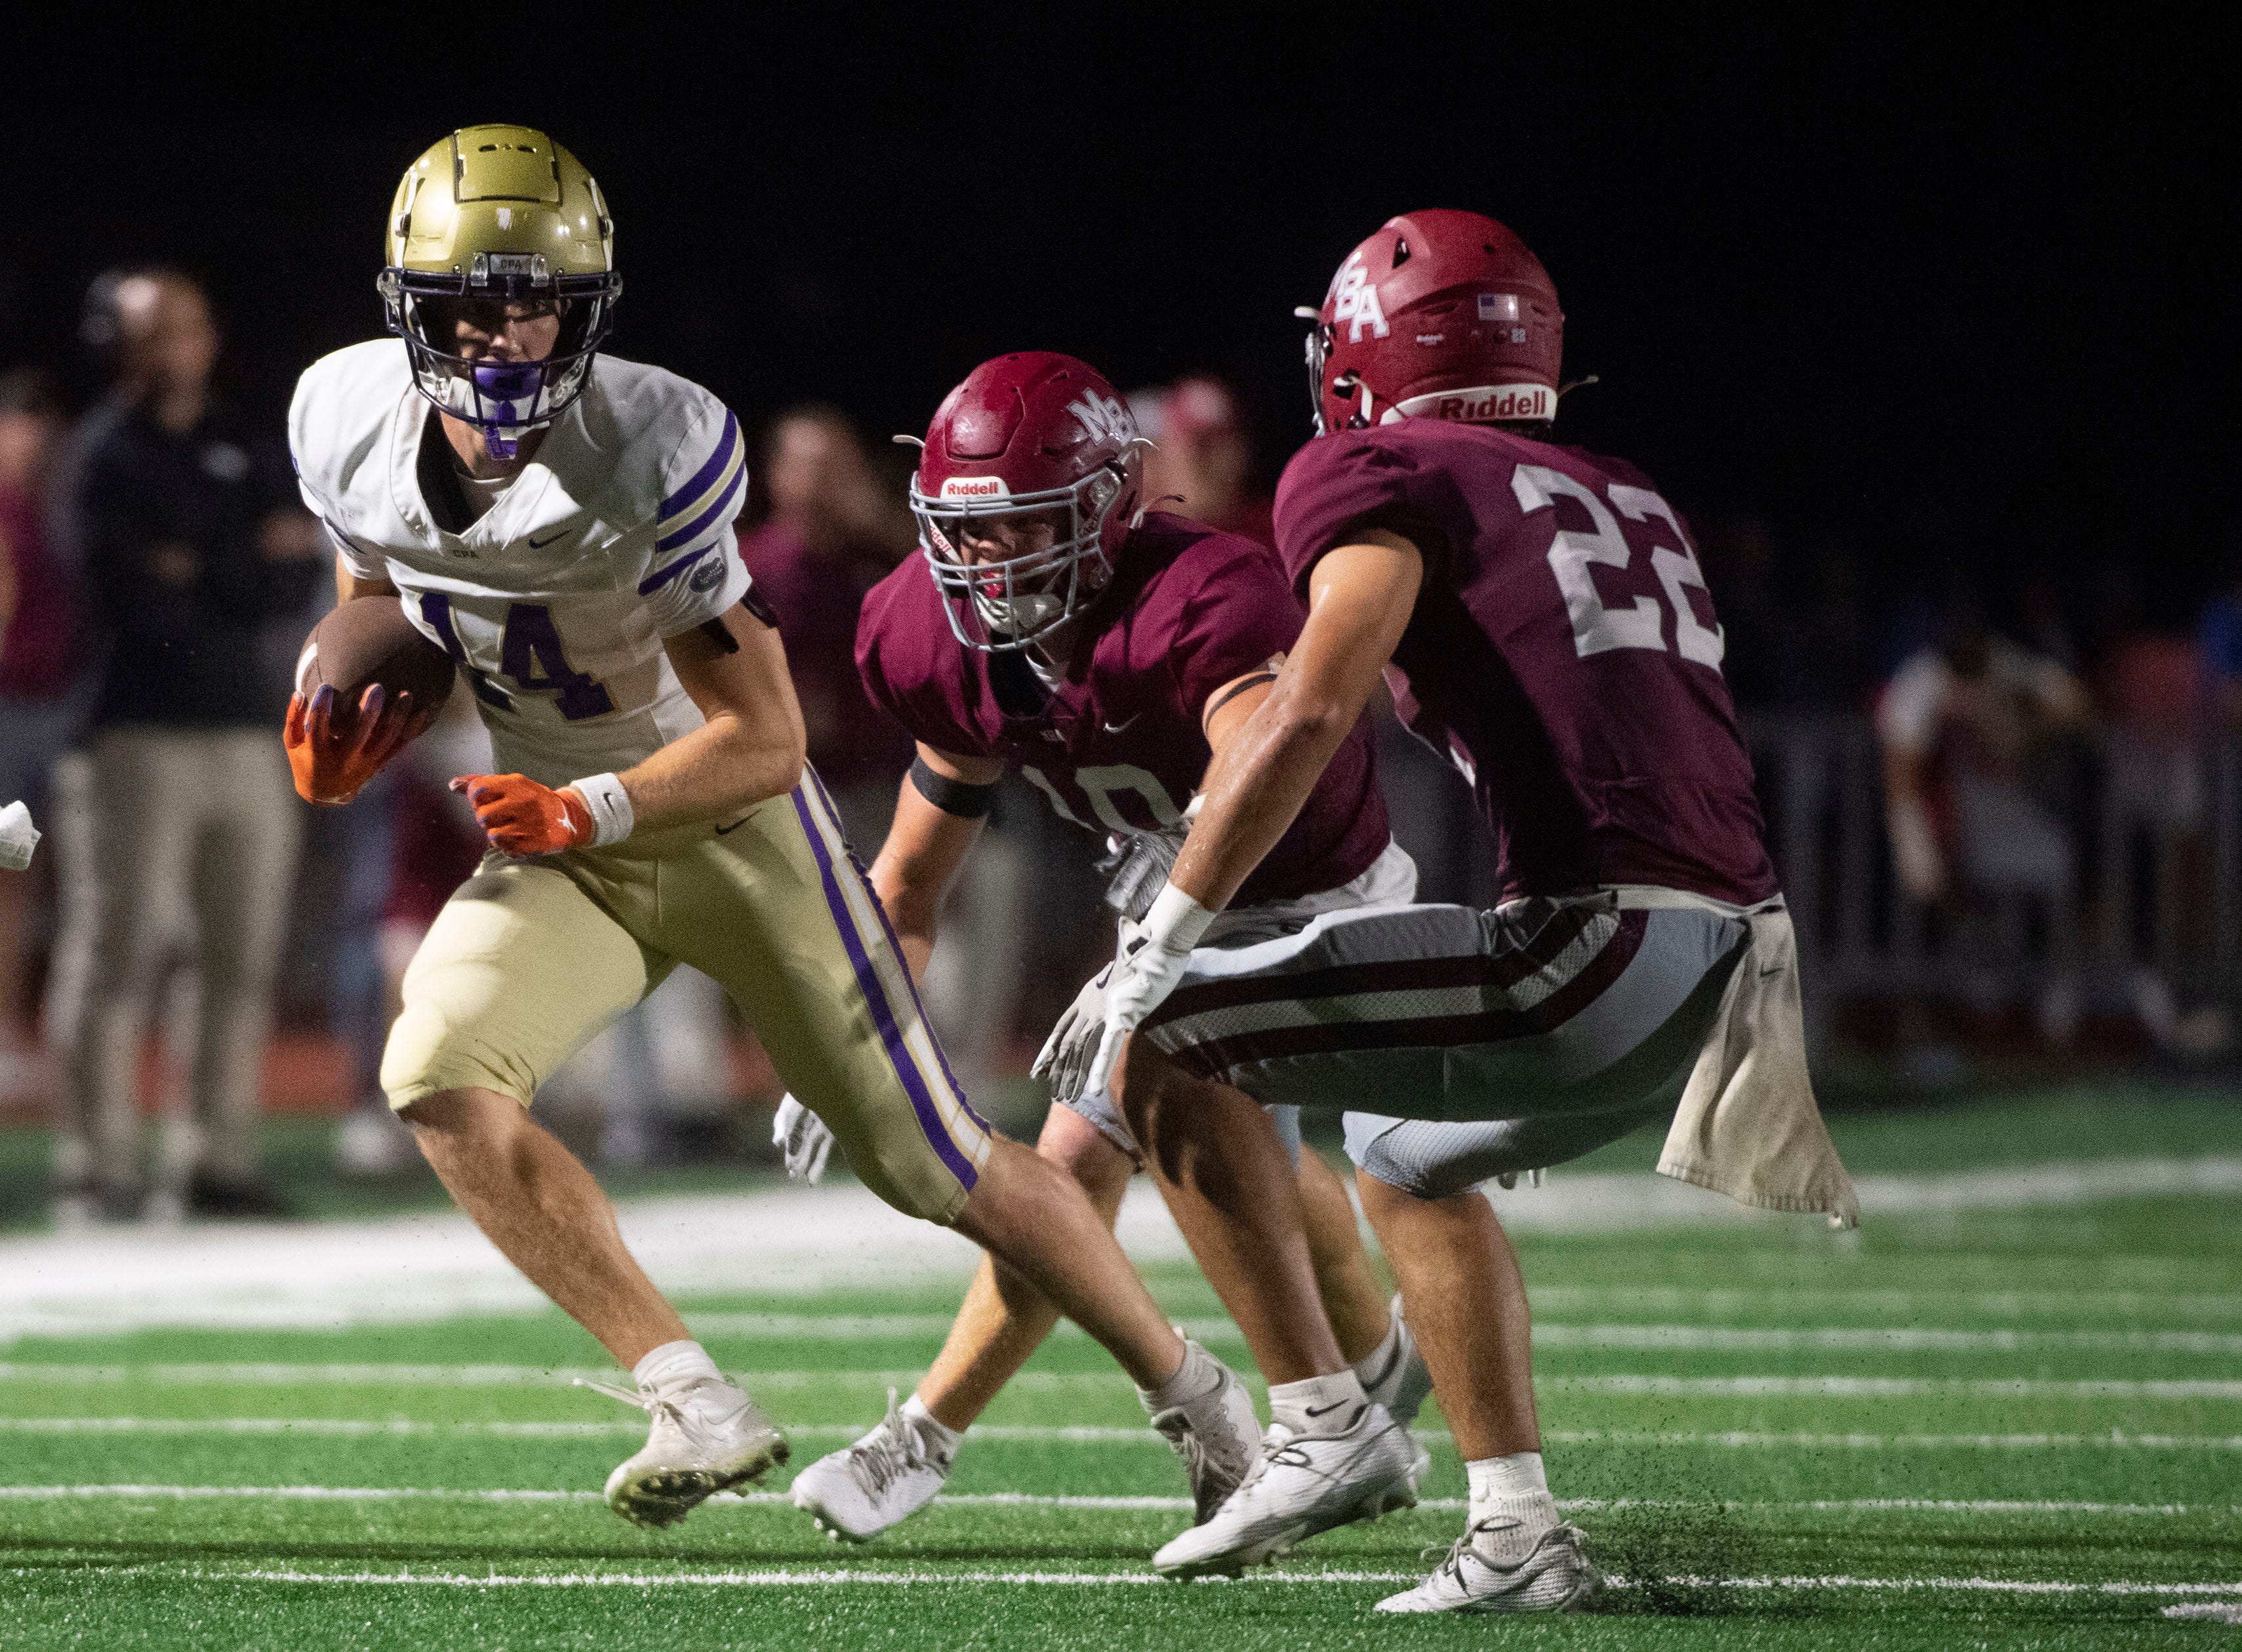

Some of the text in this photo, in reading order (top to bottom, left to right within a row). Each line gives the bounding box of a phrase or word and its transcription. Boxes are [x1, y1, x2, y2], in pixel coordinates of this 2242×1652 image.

[1066, 387, 1139, 447] MB
[1439, 391, 1546, 419] Riddell
[948, 482, 999, 494] Riddell
[1511, 464, 1725, 676] 22
[420, 592, 614, 720] 14
